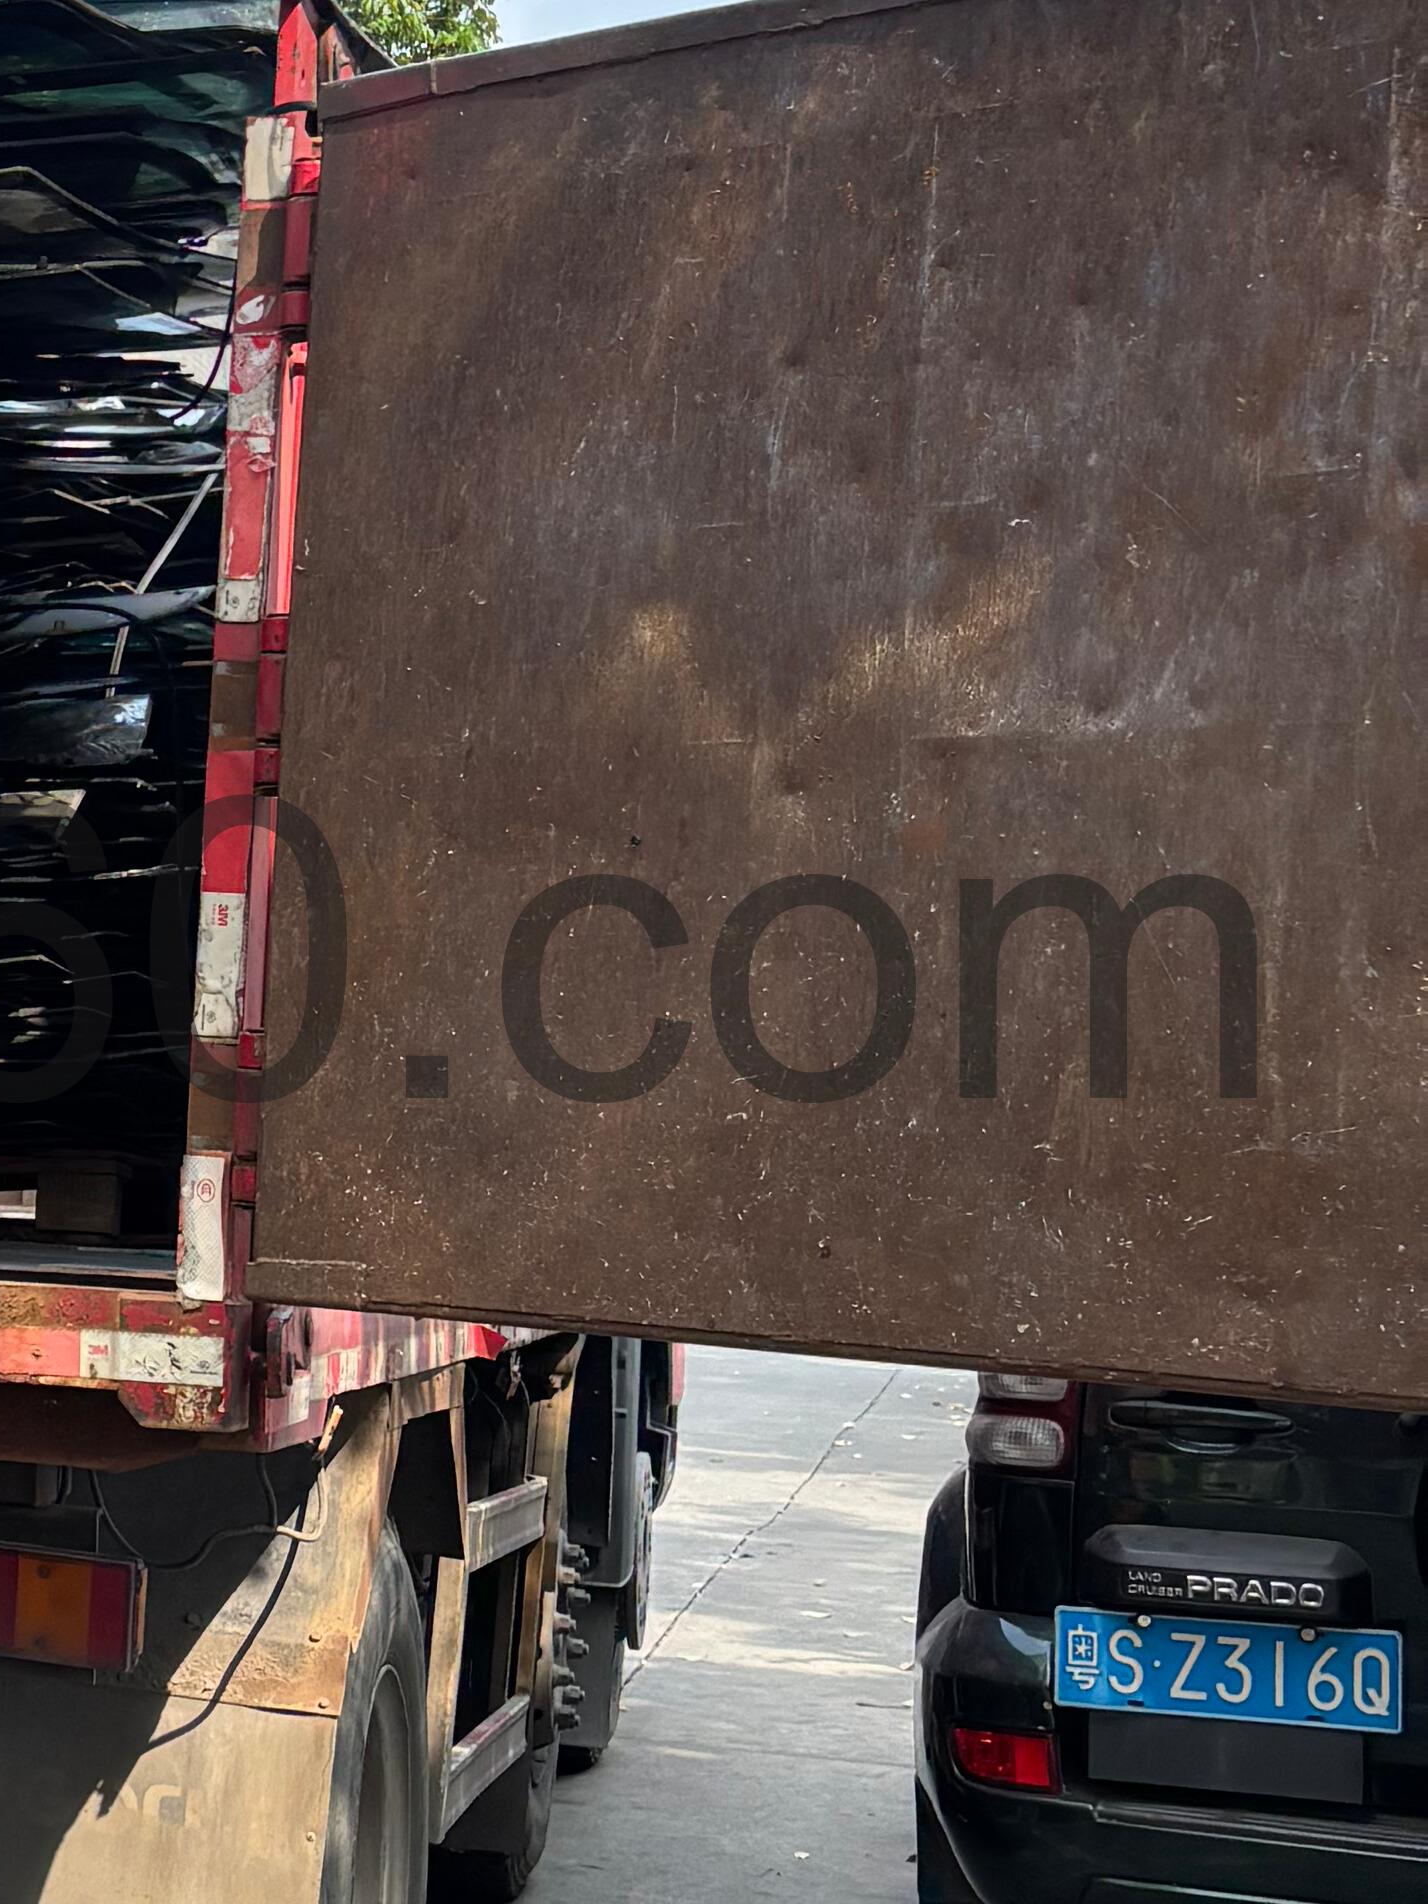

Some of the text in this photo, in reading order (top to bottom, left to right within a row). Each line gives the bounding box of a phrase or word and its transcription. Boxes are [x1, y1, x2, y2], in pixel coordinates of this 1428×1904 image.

[1127, 1570, 1162, 1582] LAND
[1127, 1583, 1184, 1598] CRUISER
[1185, 1574, 1325, 1609] PRADO
